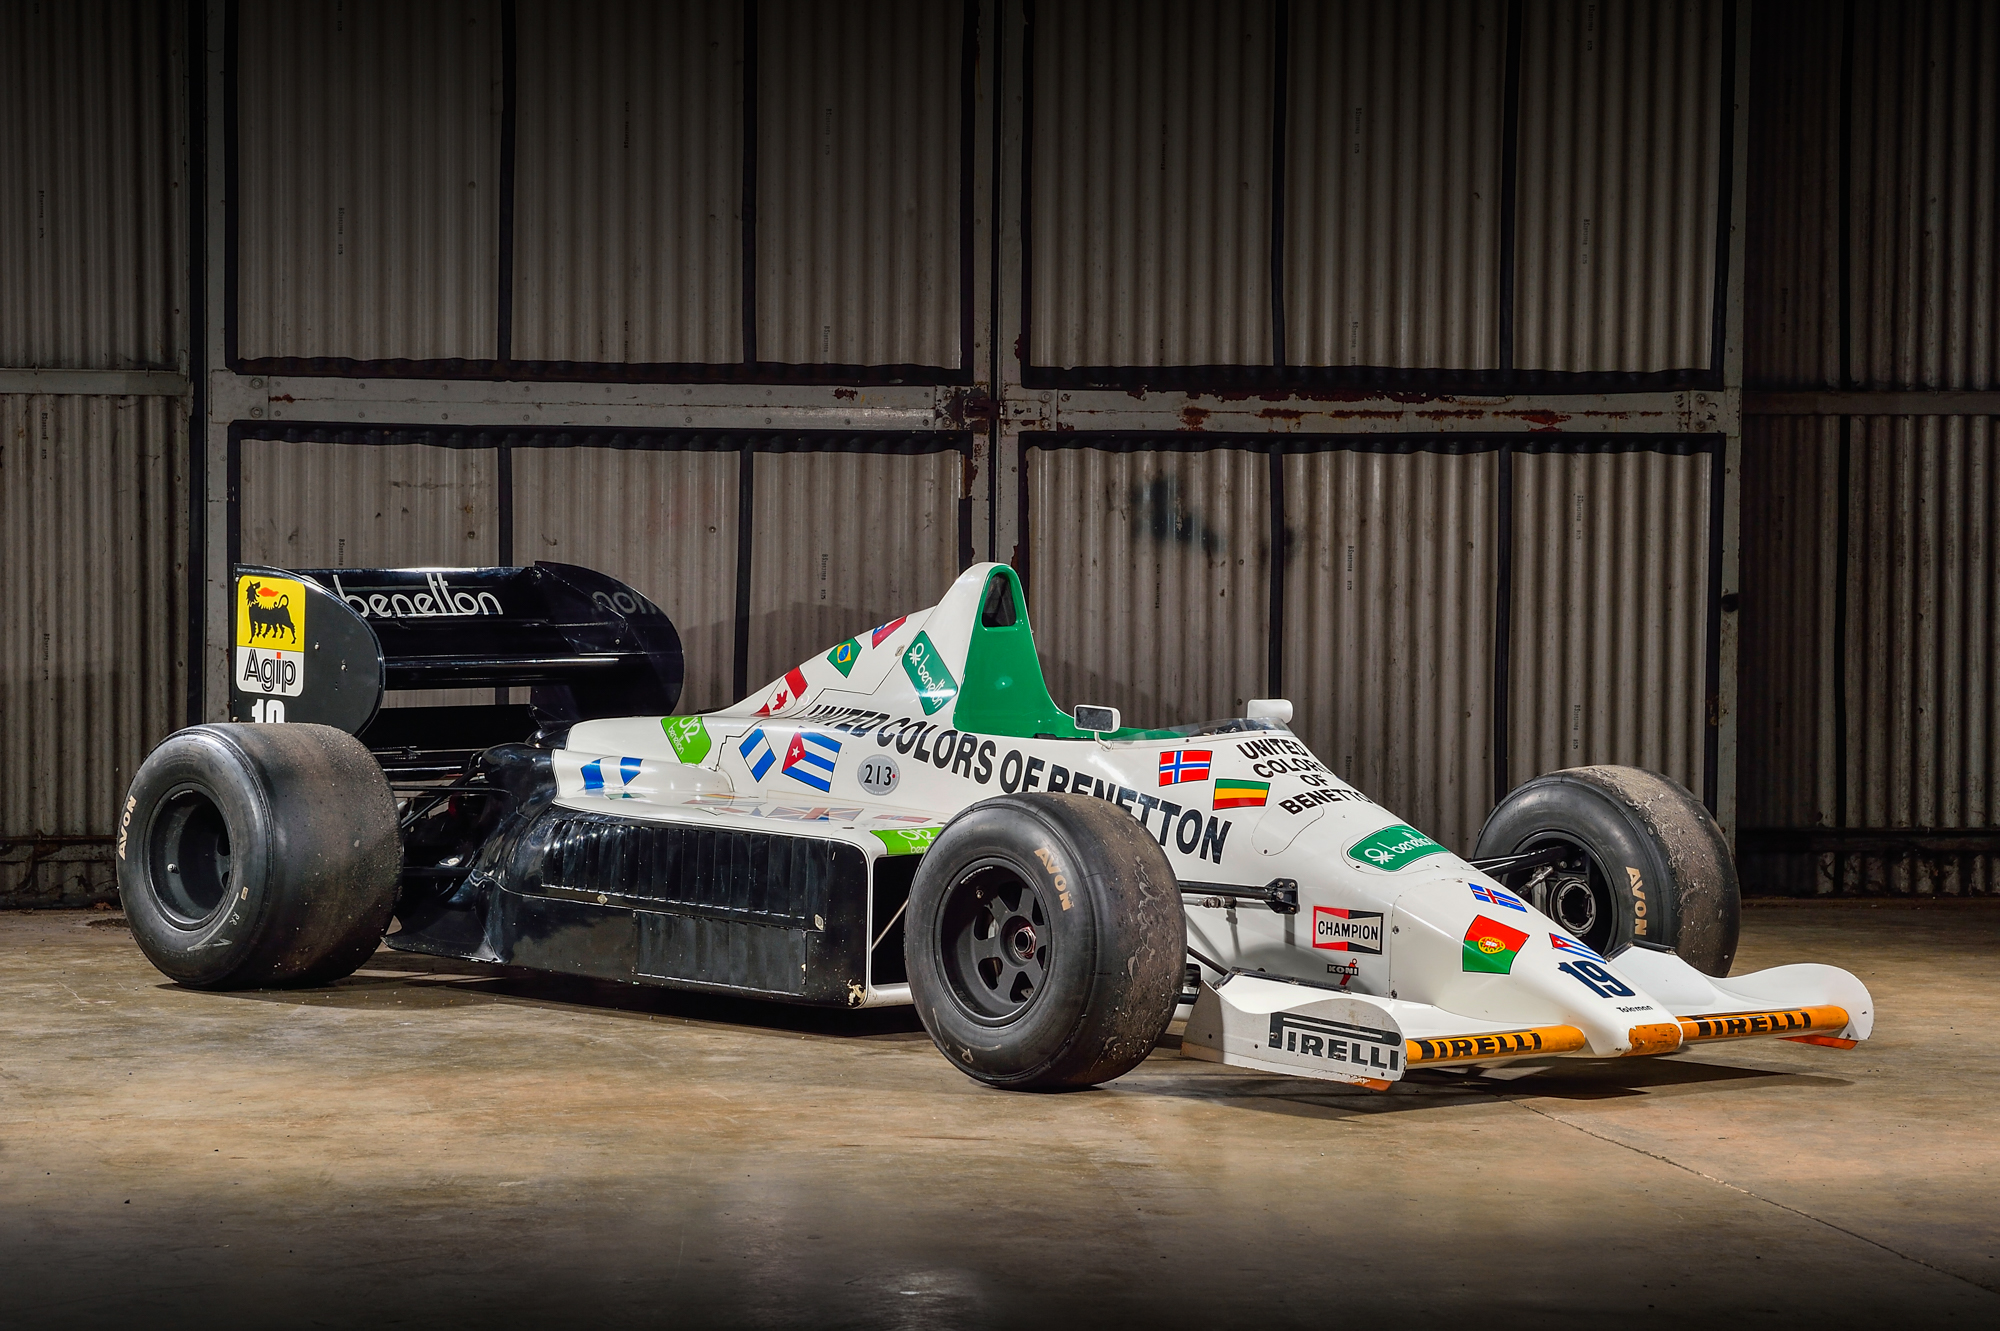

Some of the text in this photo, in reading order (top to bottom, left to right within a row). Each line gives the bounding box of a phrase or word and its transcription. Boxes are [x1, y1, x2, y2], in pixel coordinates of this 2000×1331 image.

[333, 572, 504, 617] benetton
[243, 649, 297, 693] Agip
[808, 704, 890, 738] UNITED
[876, 717, 997, 784] COLORS
[1000, 749, 1046, 793] OF
[1236, 738, 1309, 760] UNITED
[863, 764, 892, 786] 213
[1299, 774, 1329, 787] OF
[118, 794, 137, 861] AVON
[1033, 847, 1075, 911] AVON
[1625, 866, 1647, 936] AVON
[1318, 920, 1379, 941] CHAMPION
[1328, 965, 1358, 976] KONI
[1557, 960, 1636, 998] 19
[1268, 1011, 1400, 1072] PIRELLI
[1684, 1008, 1812, 1037] PIRELLI
[1407, 1029, 1543, 1060] PIRELLI
